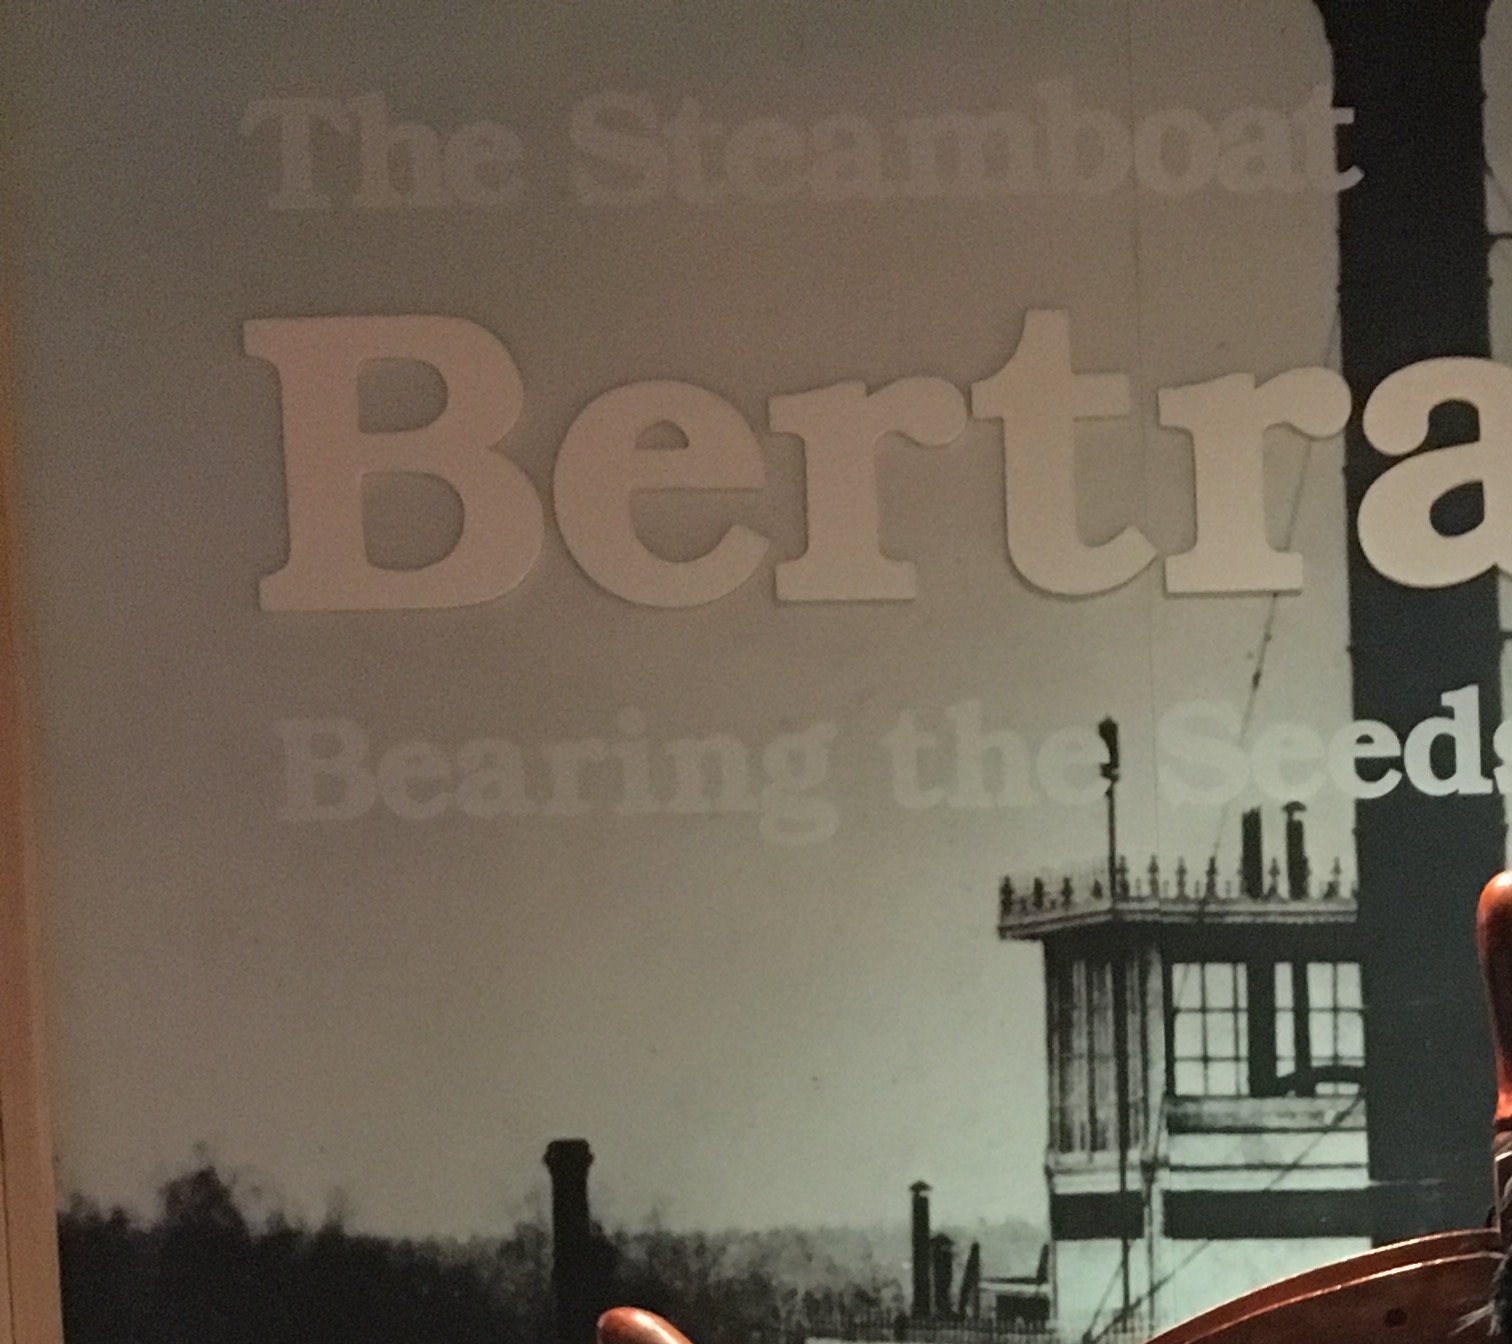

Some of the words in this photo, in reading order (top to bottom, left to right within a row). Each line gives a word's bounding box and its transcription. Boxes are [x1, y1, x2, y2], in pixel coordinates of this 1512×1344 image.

[240, 93, 524, 210] The
[568, 77, 1364, 206] Steamboat
[273, 704, 840, 844] Bearing
[880, 698, 1118, 811] the
